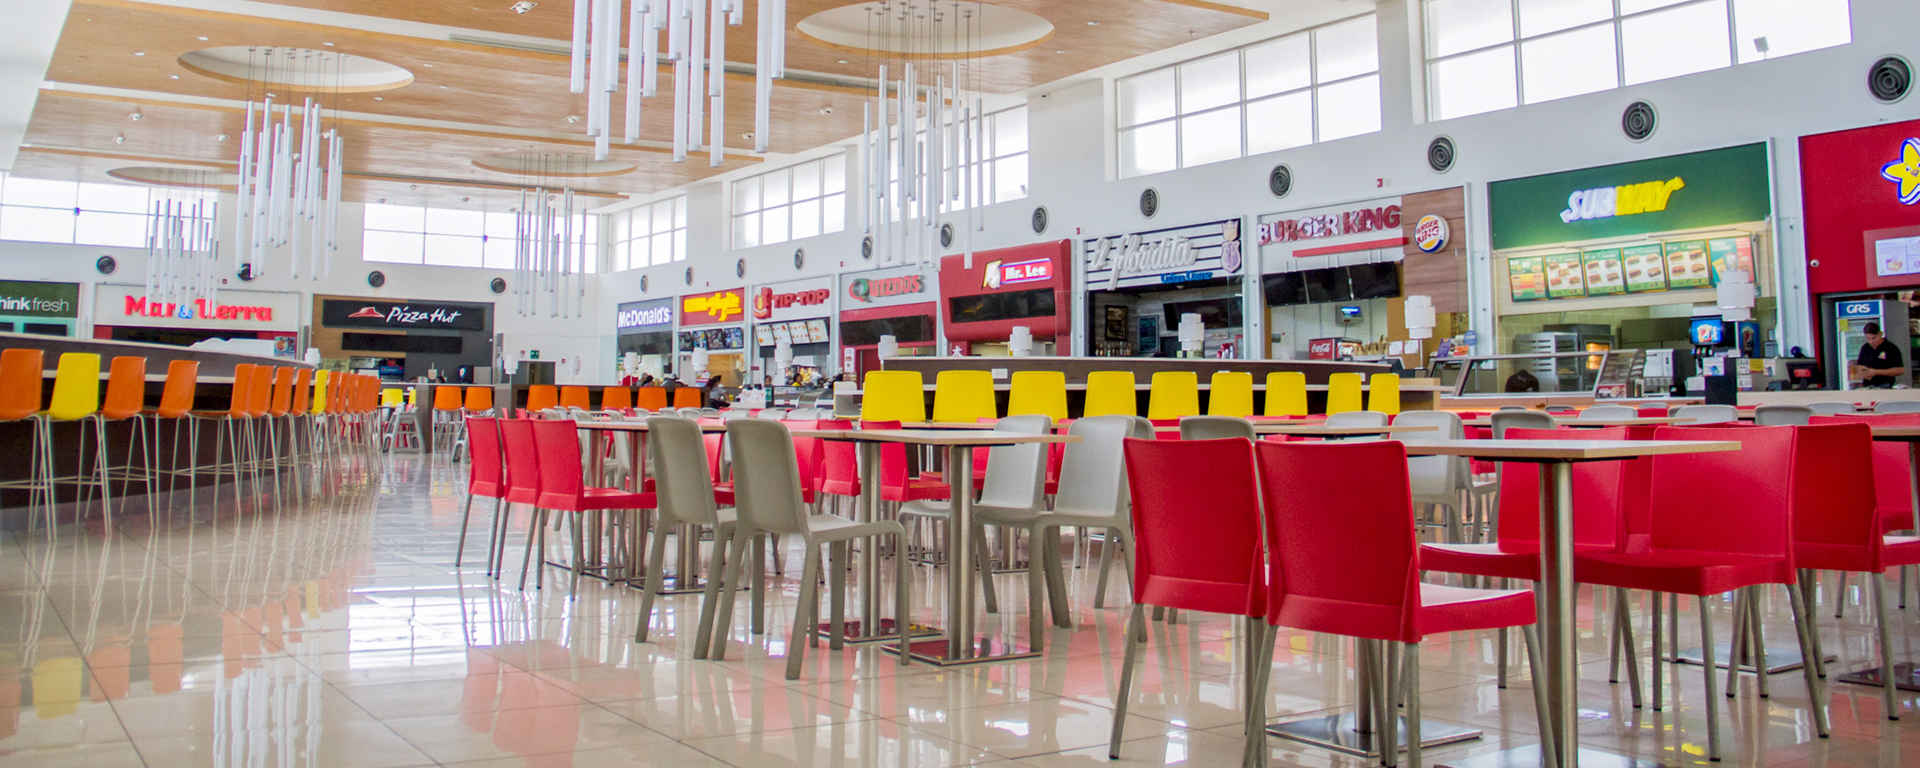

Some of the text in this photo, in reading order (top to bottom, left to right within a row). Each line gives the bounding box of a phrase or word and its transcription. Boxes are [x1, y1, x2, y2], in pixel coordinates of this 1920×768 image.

[1559, 176, 1685, 223] SUBWAY
[1257, 204, 1401, 246] BURGER KING
[1416, 219, 1439, 235] BURGER
[1417, 226, 1439, 246] KING
[1005, 265, 1046, 280] Mr. Lee
[0, 296, 70, 313] hink fresh
[124, 295, 272, 322] Mar & Tierra
[771, 288, 830, 309] TIP-TOP
[1846, 303, 1871, 314] GRS
[385, 306, 462, 323] Pizza Hut
[617, 306, 671, 328] McDonald's
